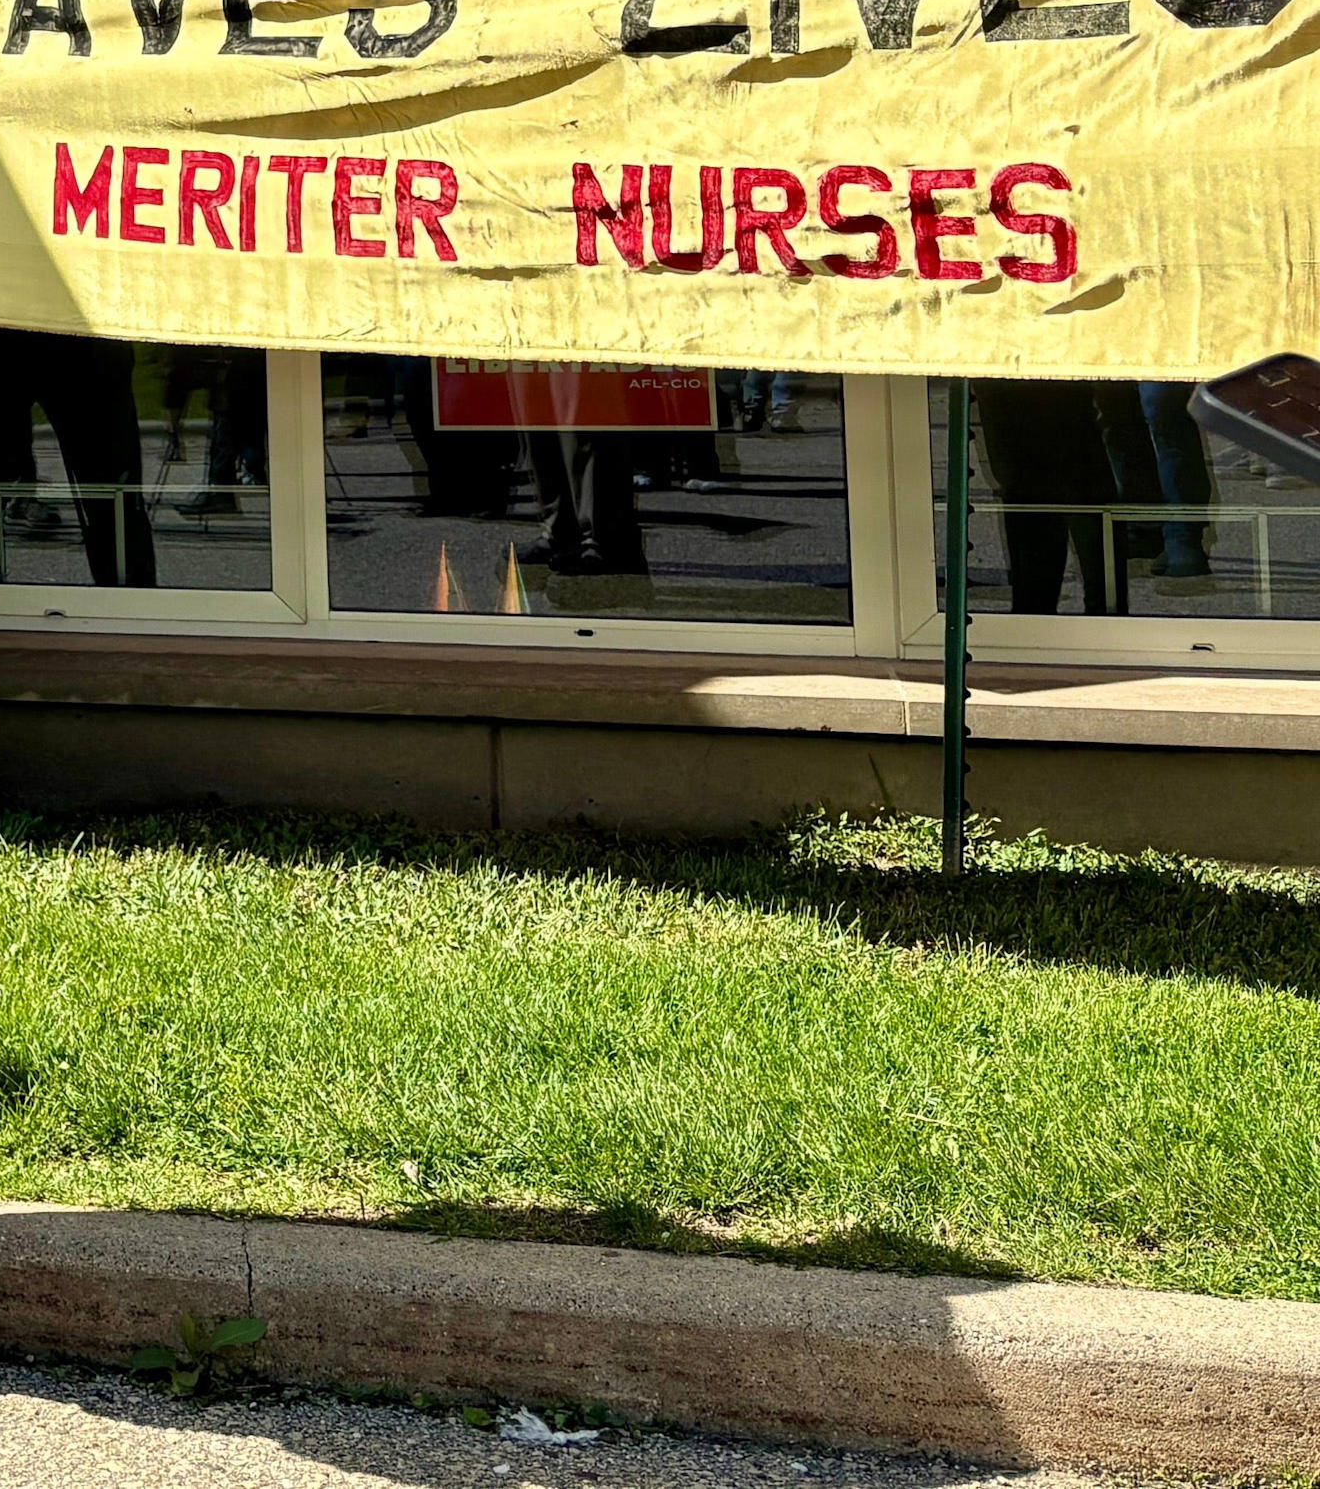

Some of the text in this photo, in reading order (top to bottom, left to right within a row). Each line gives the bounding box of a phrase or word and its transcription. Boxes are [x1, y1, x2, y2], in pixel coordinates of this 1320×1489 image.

[52, 142, 1078, 283] MERITER NURSES
[629, 379, 702, 389] AFL-CIO
